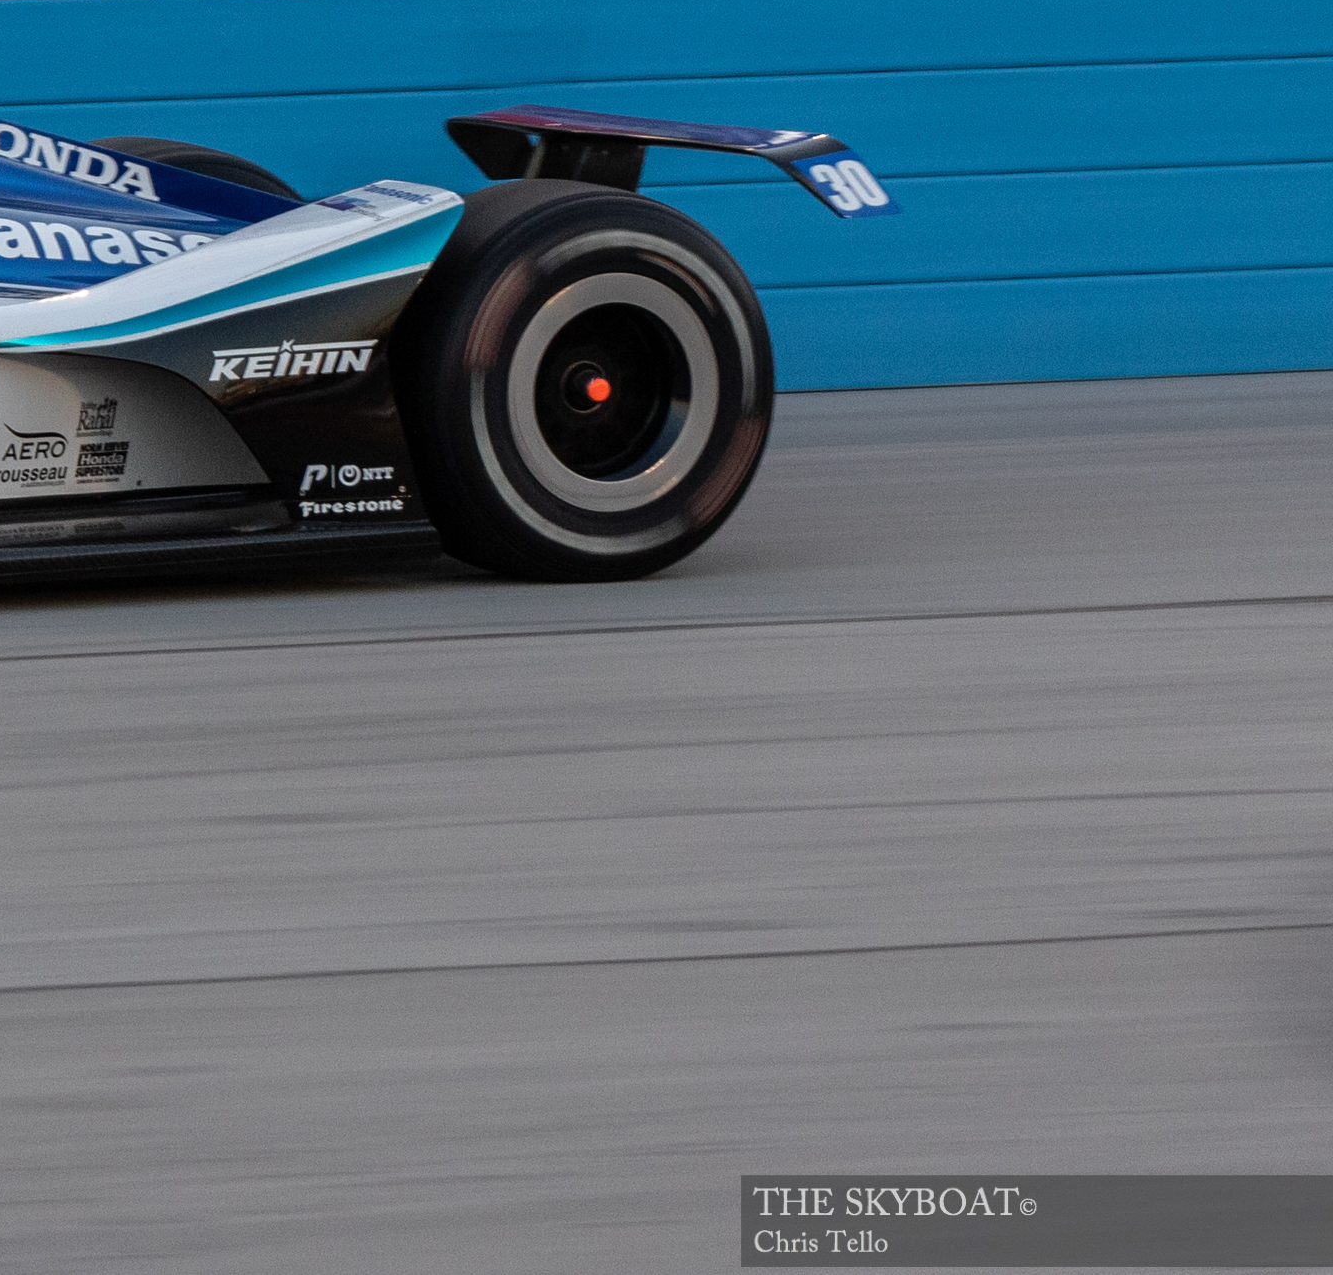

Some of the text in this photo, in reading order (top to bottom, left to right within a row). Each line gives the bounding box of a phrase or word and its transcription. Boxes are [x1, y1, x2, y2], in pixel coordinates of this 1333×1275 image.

[809, 159, 890, 211] 30
[209, 339, 379, 381] KEIHIN
[2, 440, 66, 461] AERO
[80, 453, 124, 465] Honda
[362, 467, 394, 480] NTT
[299, 499, 404, 517] Firestone
